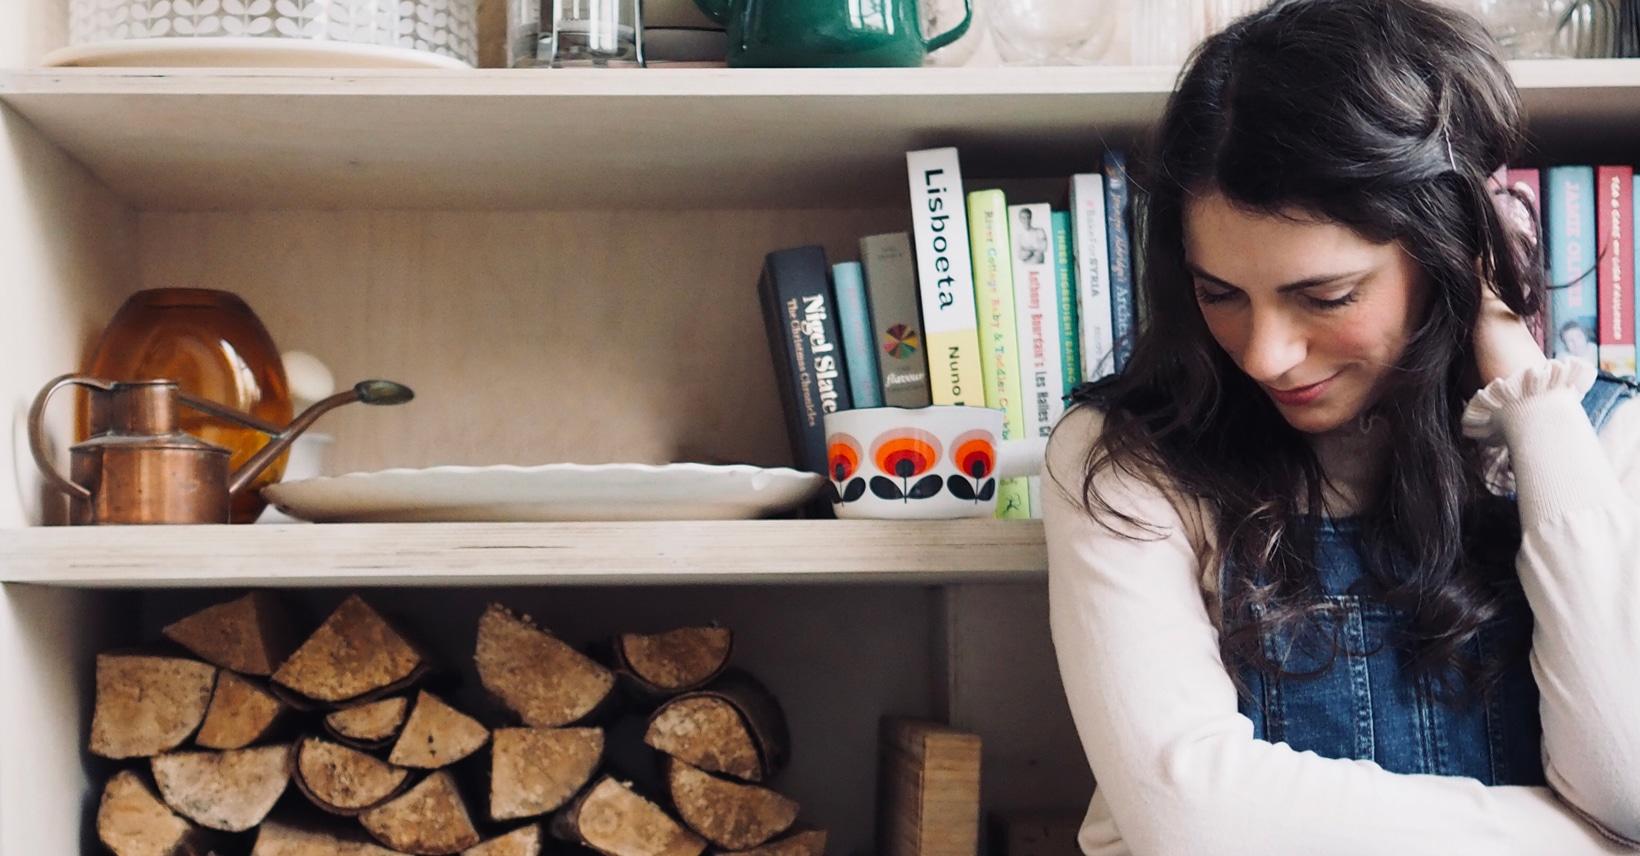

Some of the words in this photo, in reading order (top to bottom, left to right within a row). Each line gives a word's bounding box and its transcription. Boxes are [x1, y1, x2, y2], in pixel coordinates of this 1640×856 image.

[984, 209, 995, 242] River
[1564, 181, 1581, 238] JAMIE
[1611, 209, 1620, 239] CAKE
[924, 168, 955, 311] Lisboeta
[1057, 228, 1068, 265] THREE
[787, 298, 798, 319] The
[991, 298, 1002, 329] Baby
[1028, 271, 1040, 309] Anthony
[1060, 267, 1073, 337] INGREDIENT
[791, 320, 806, 372] Christmas
[801, 293, 833, 354] Nigel
[1031, 313, 1044, 368] Bourdain's
[814, 355, 839, 414] Slate
[885, 373, 924, 388] flavour
[948, 346, 961, 396] Nuno
[994, 345, 1006, 393] Toddler
[1035, 371, 1047, 388] Les
[1065, 339, 1076, 384] BAKING
[800, 372, 816, 427] Chronicles
